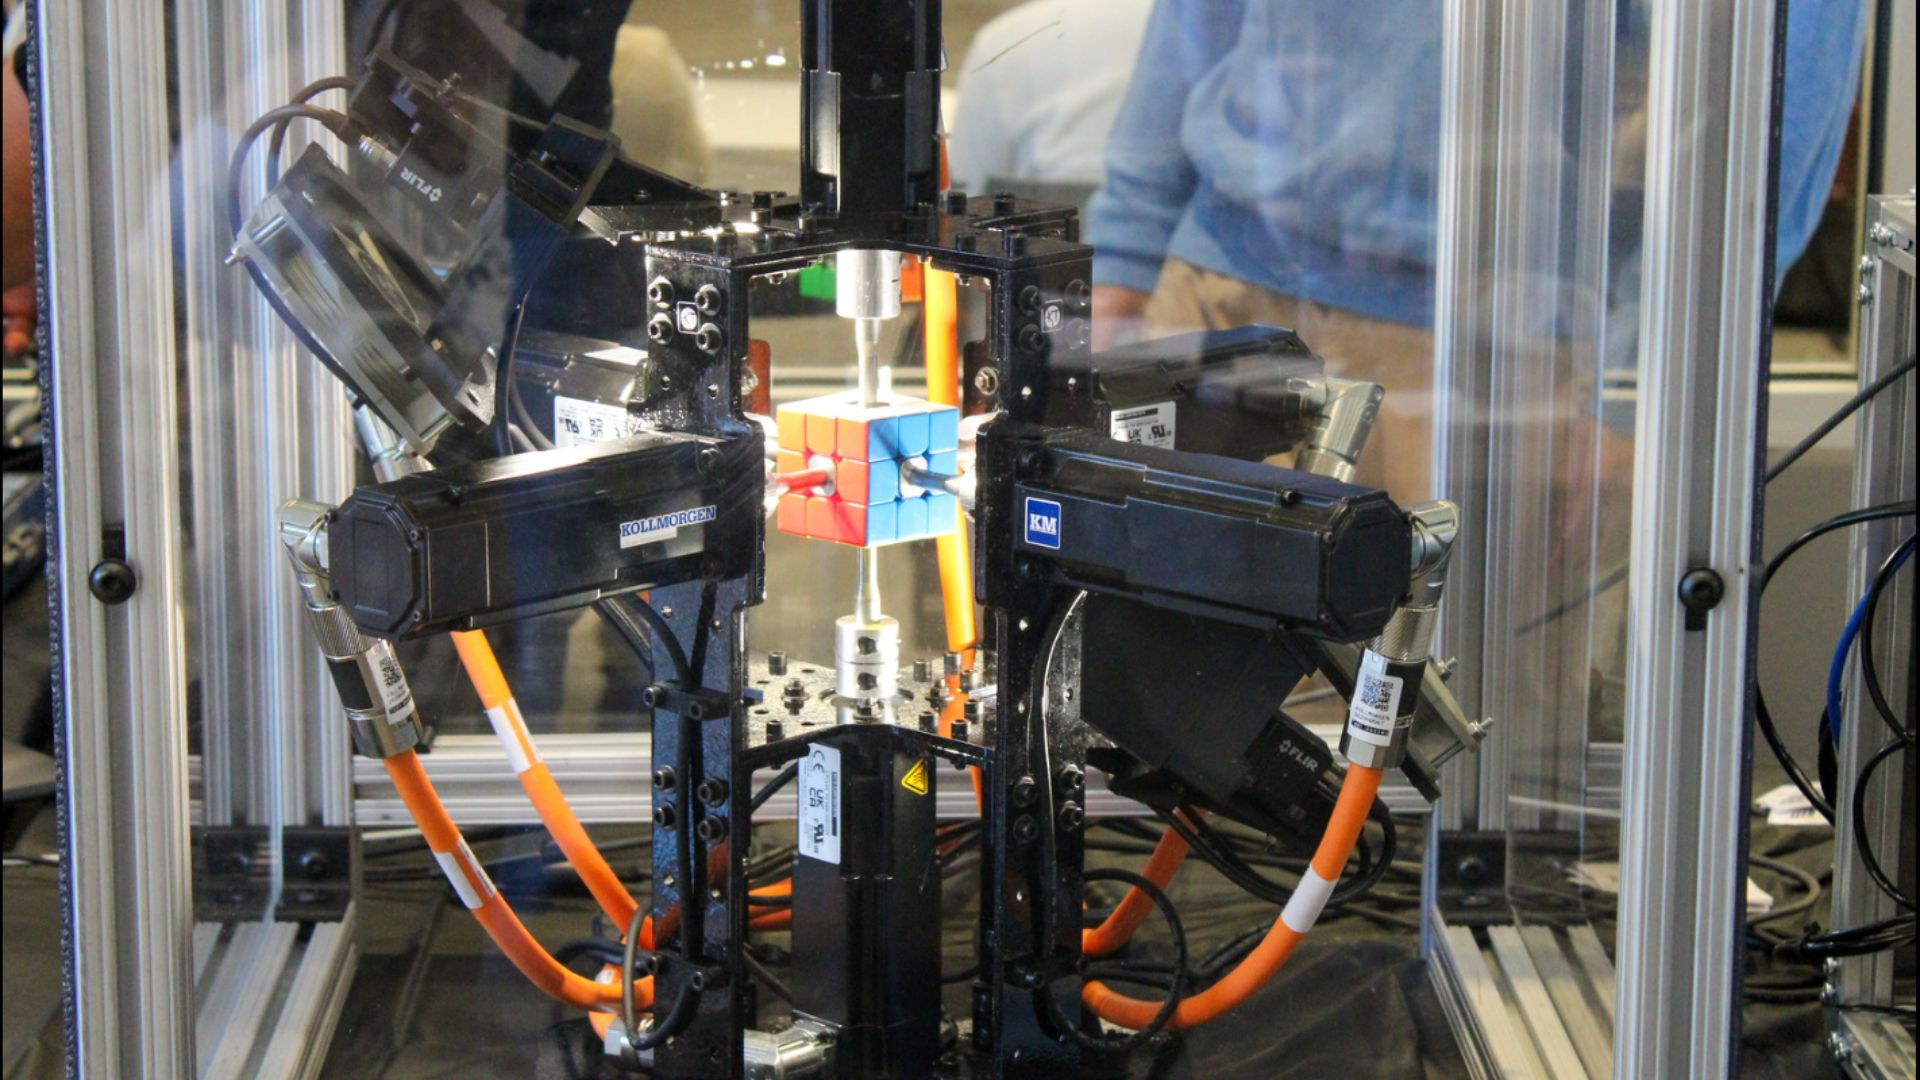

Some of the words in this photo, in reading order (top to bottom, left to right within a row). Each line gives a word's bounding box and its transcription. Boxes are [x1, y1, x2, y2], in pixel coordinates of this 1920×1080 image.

[621, 506, 716, 537] KOLLMORGEN
[1029, 513, 1057, 535] KM
[1288, 746, 1319, 772] FLIR
